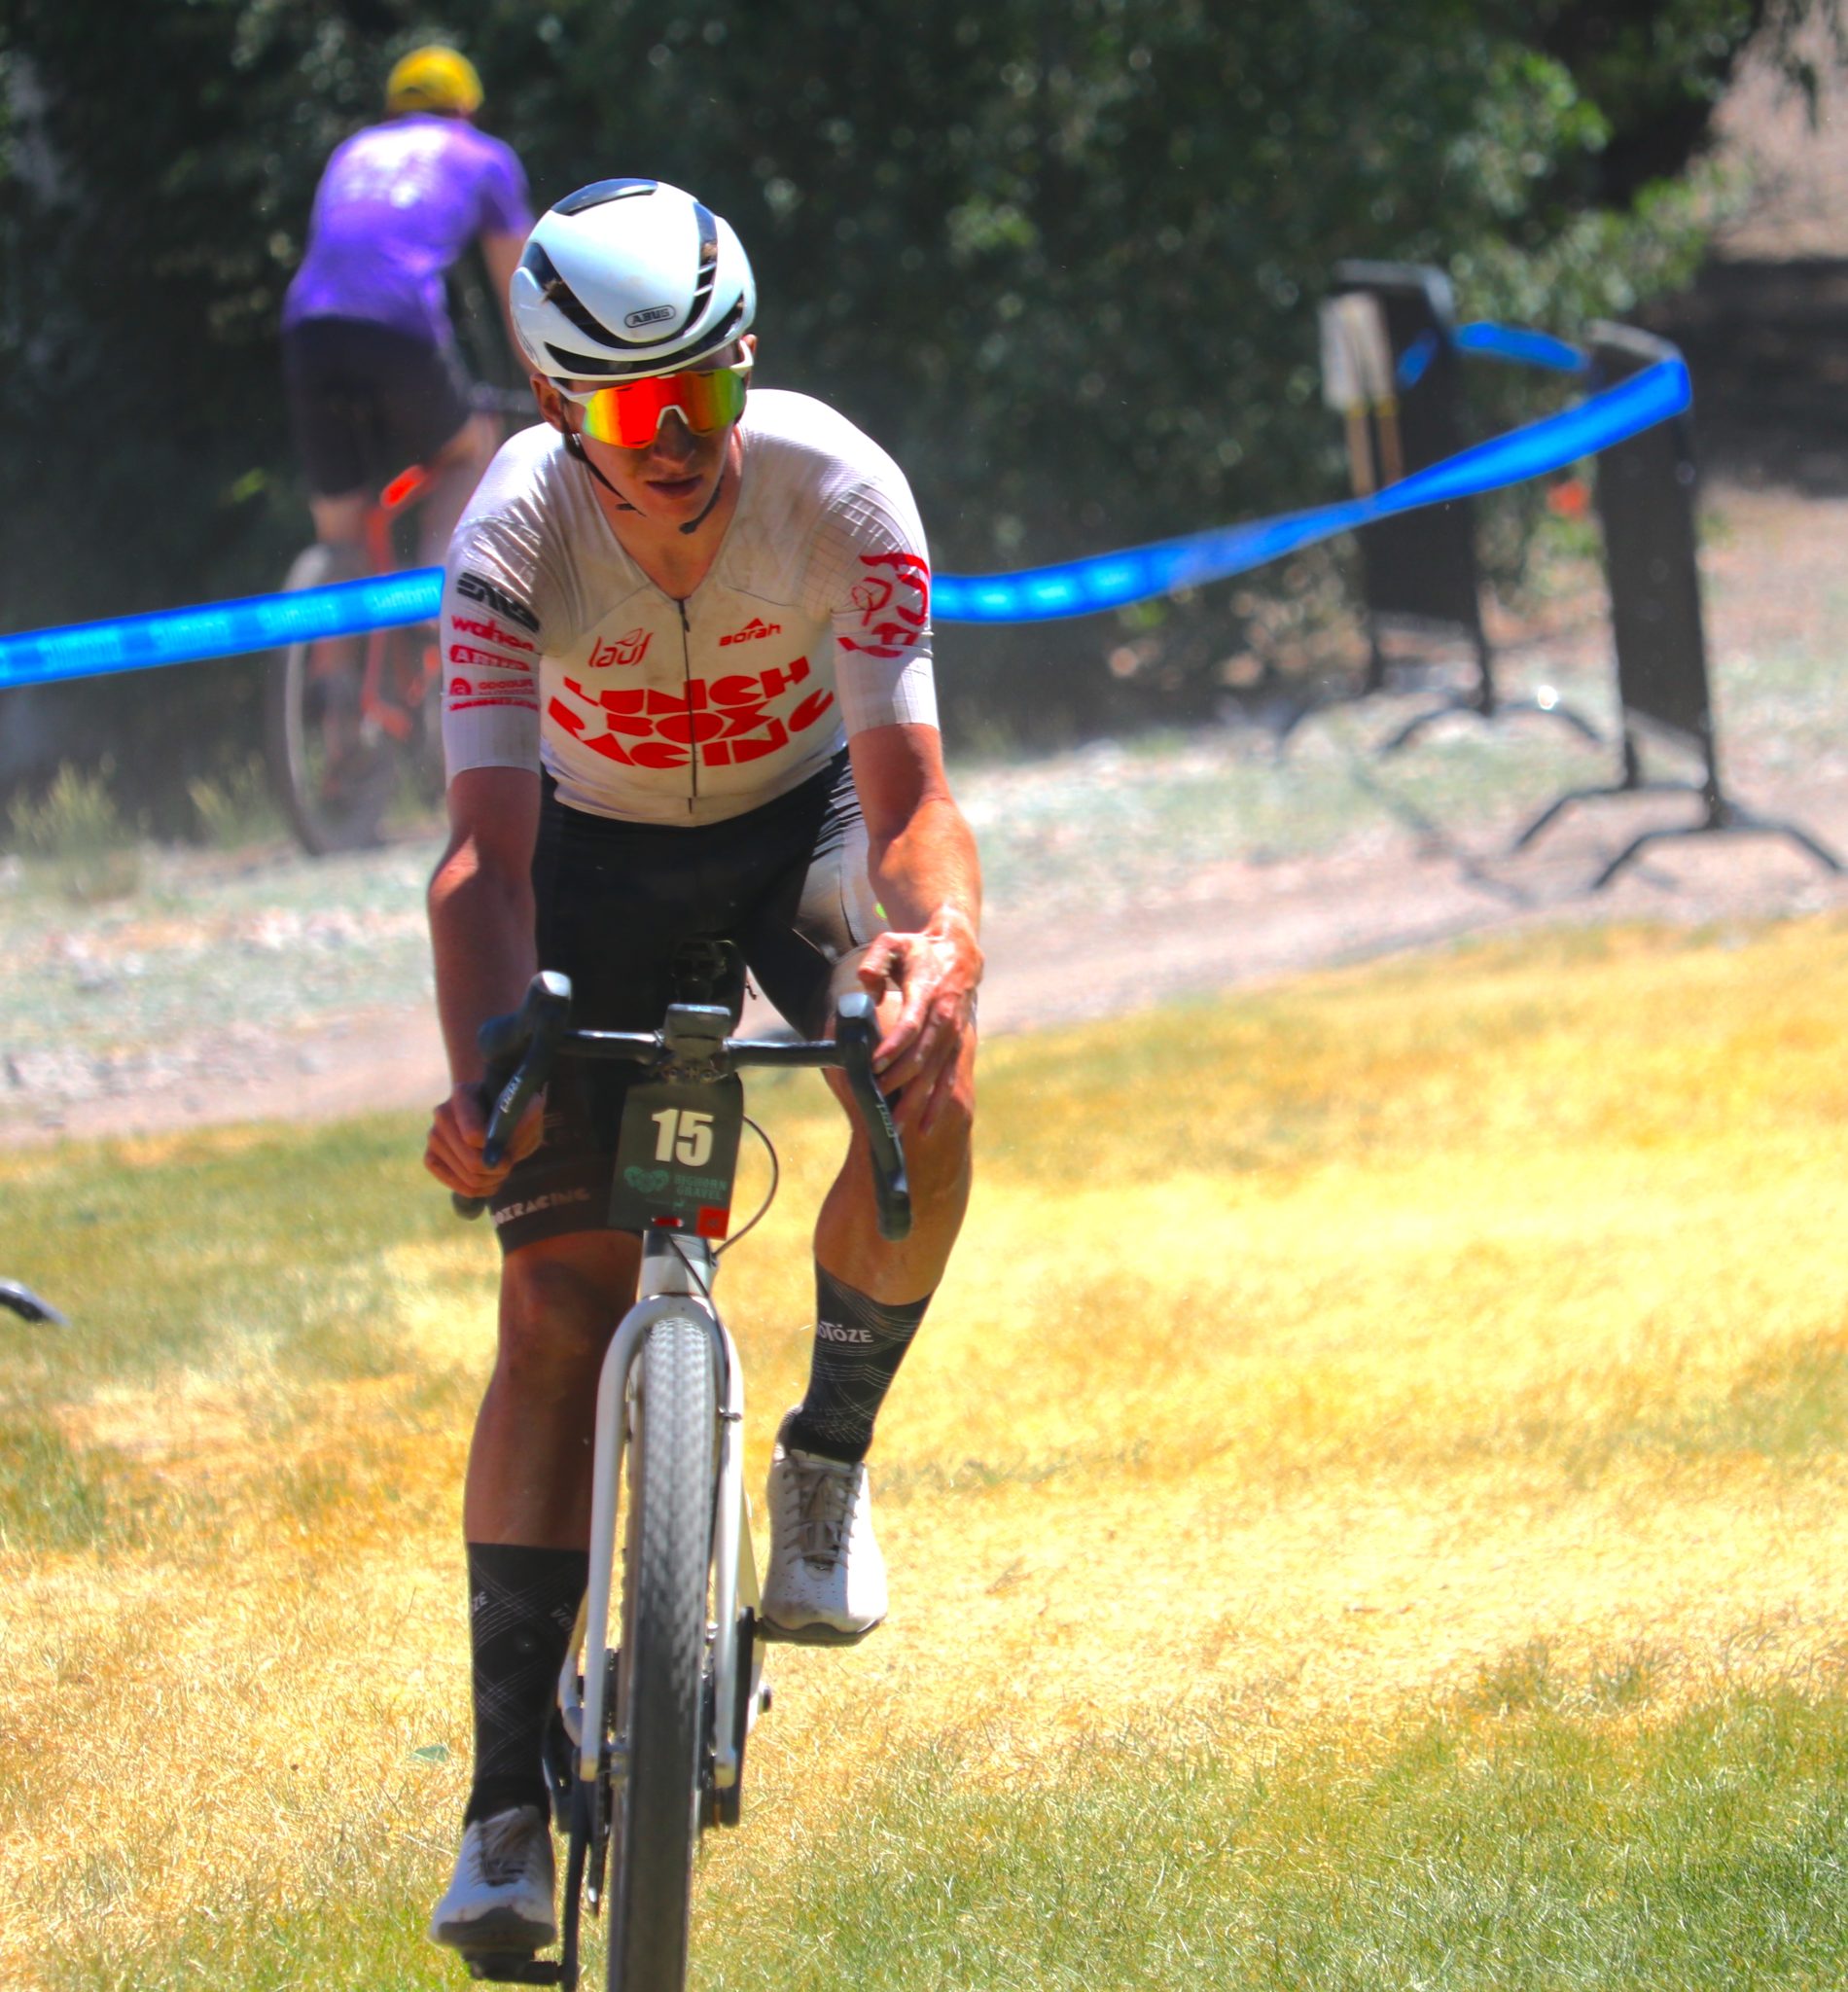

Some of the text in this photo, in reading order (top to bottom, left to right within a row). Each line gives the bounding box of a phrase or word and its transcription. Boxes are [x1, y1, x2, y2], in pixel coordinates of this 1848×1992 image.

[632, 307, 670, 325] ABUS
[563, 656, 810, 715] LUNCH
[548, 688, 835, 768] RACING
[606, 700, 774, 744] BOX
[652, 1109, 714, 1166] 15
